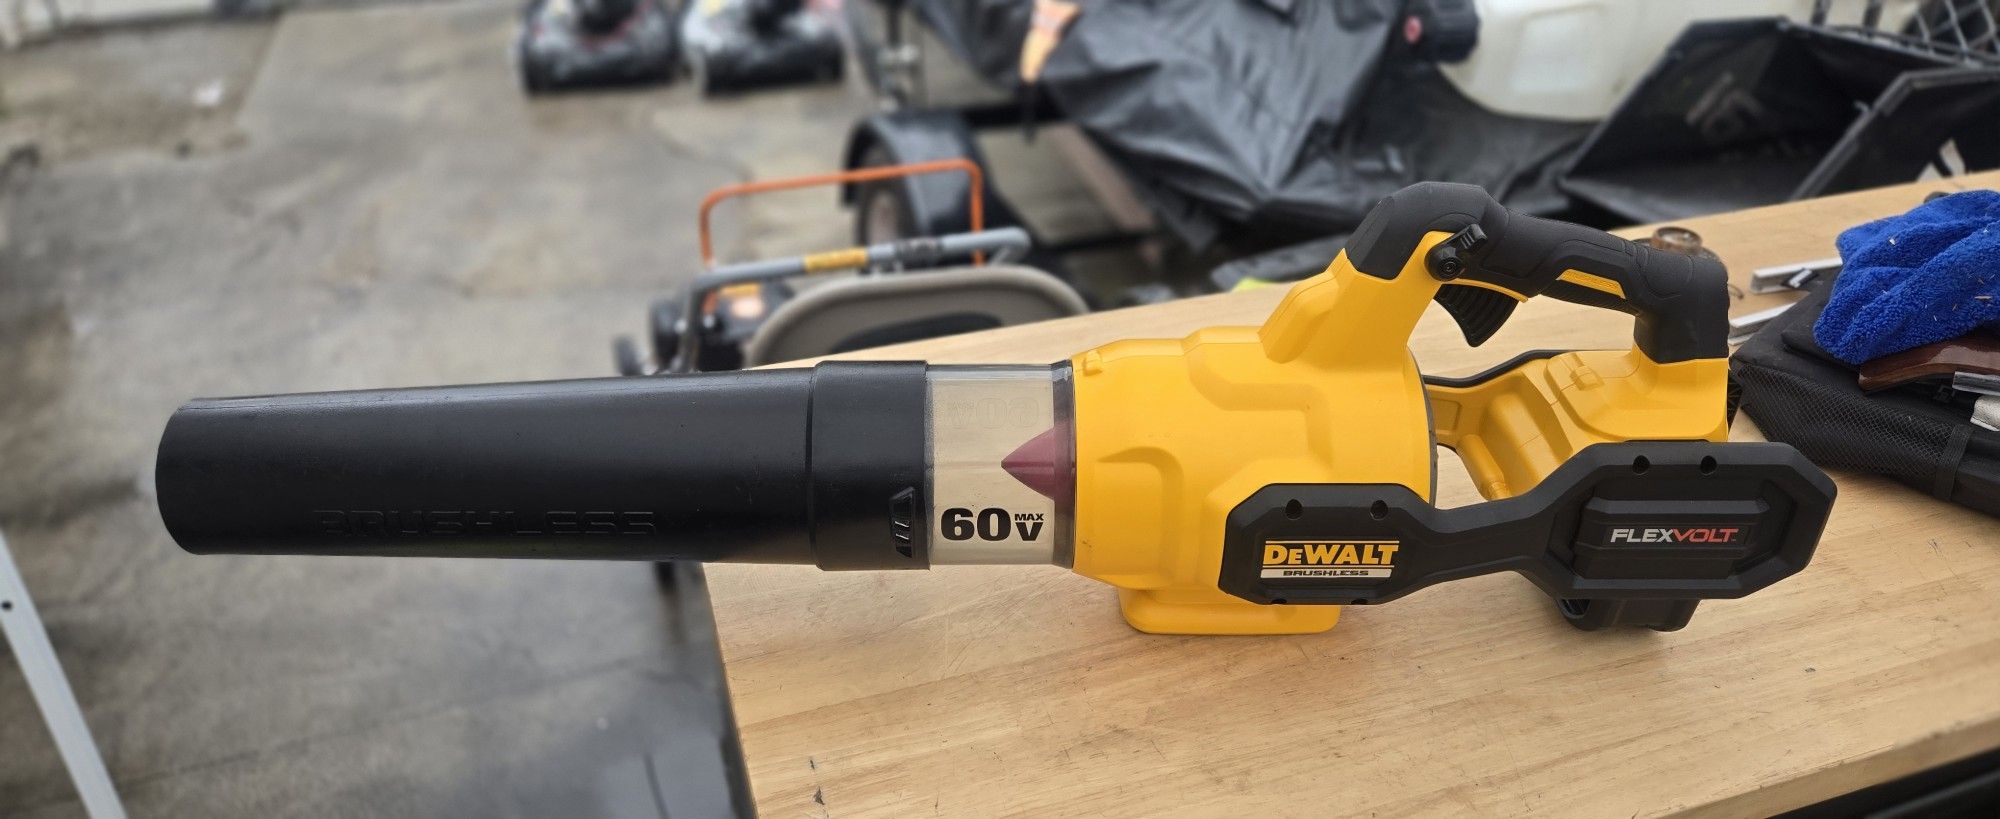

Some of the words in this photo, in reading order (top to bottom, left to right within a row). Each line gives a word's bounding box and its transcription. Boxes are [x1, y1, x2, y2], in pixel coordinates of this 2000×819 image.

[312, 509, 657, 537] BRUSHLESS
[940, 507, 1012, 541] 60
[1014, 513, 1044, 521] MAX
[1014, 522, 1044, 541] V
[1610, 528, 1739, 543] FLEXVOLT
[1283, 569, 1369, 577] BRUSHLESS
